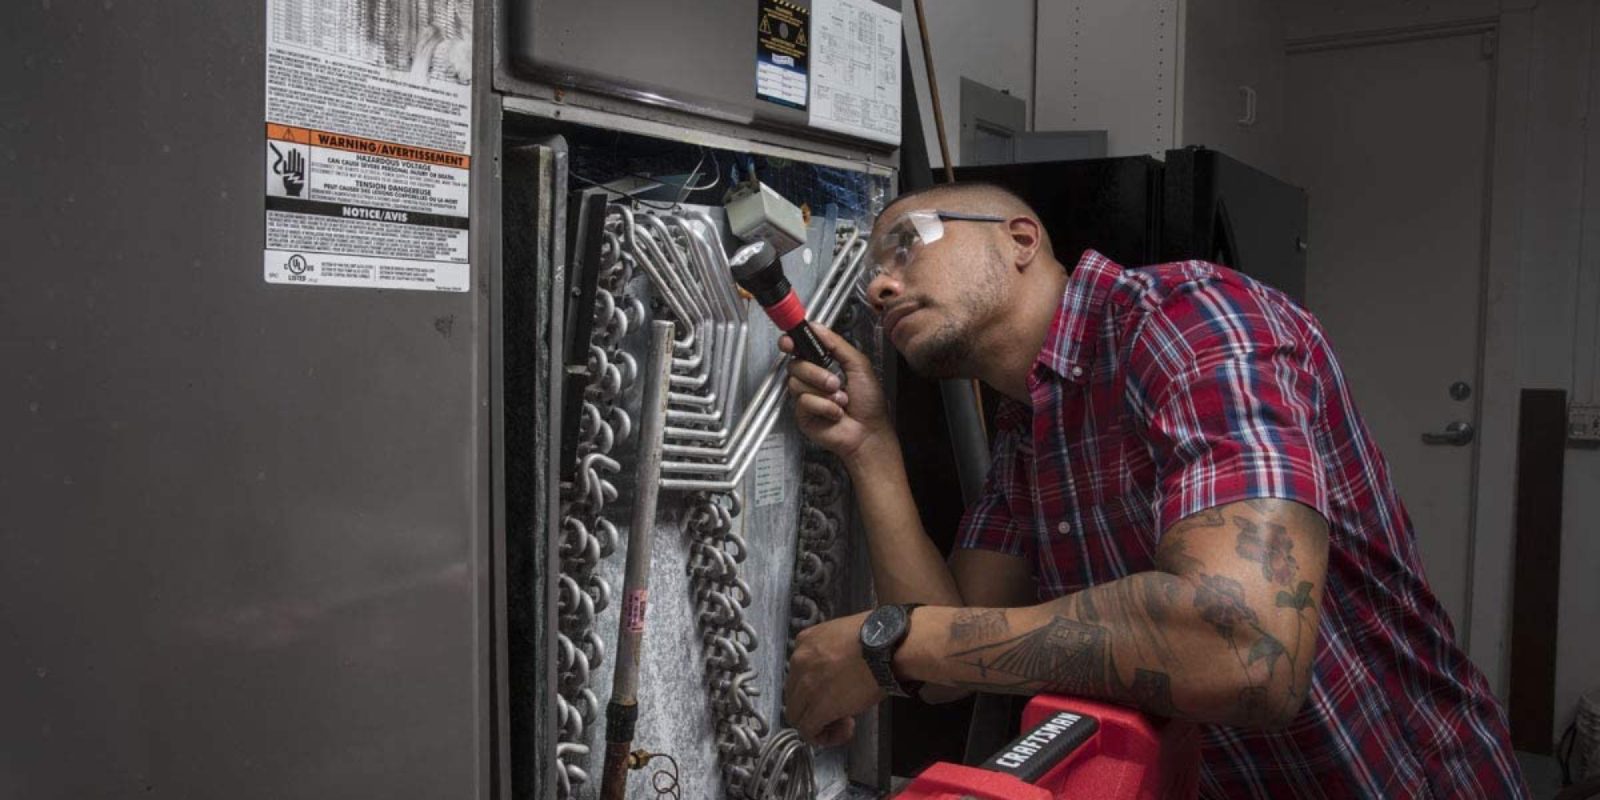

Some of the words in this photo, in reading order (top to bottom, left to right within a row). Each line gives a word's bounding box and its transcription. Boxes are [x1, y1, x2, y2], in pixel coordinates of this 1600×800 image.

[318, 134, 464, 167] WARNING/AVERTISSEMENT
[327, 157, 341, 165] CAN
[341, 159, 359, 167] CAUSE
[361, 162, 380, 170] SEVERE
[381, 165, 408, 174] PERSONAL
[356, 154, 400, 166] HAZARDOUS
[401, 161, 431, 171] VOLTAGE
[339, 185, 360, 193] CAUSER
[355, 180, 387, 190] TENSION
[388, 184, 431, 196] DANGEREUSE
[342, 206, 408, 222] NOTICE/AVIS
[288, 274, 307, 282] LISTED
[995, 711, 1083, 768] CRAFTSMAN
